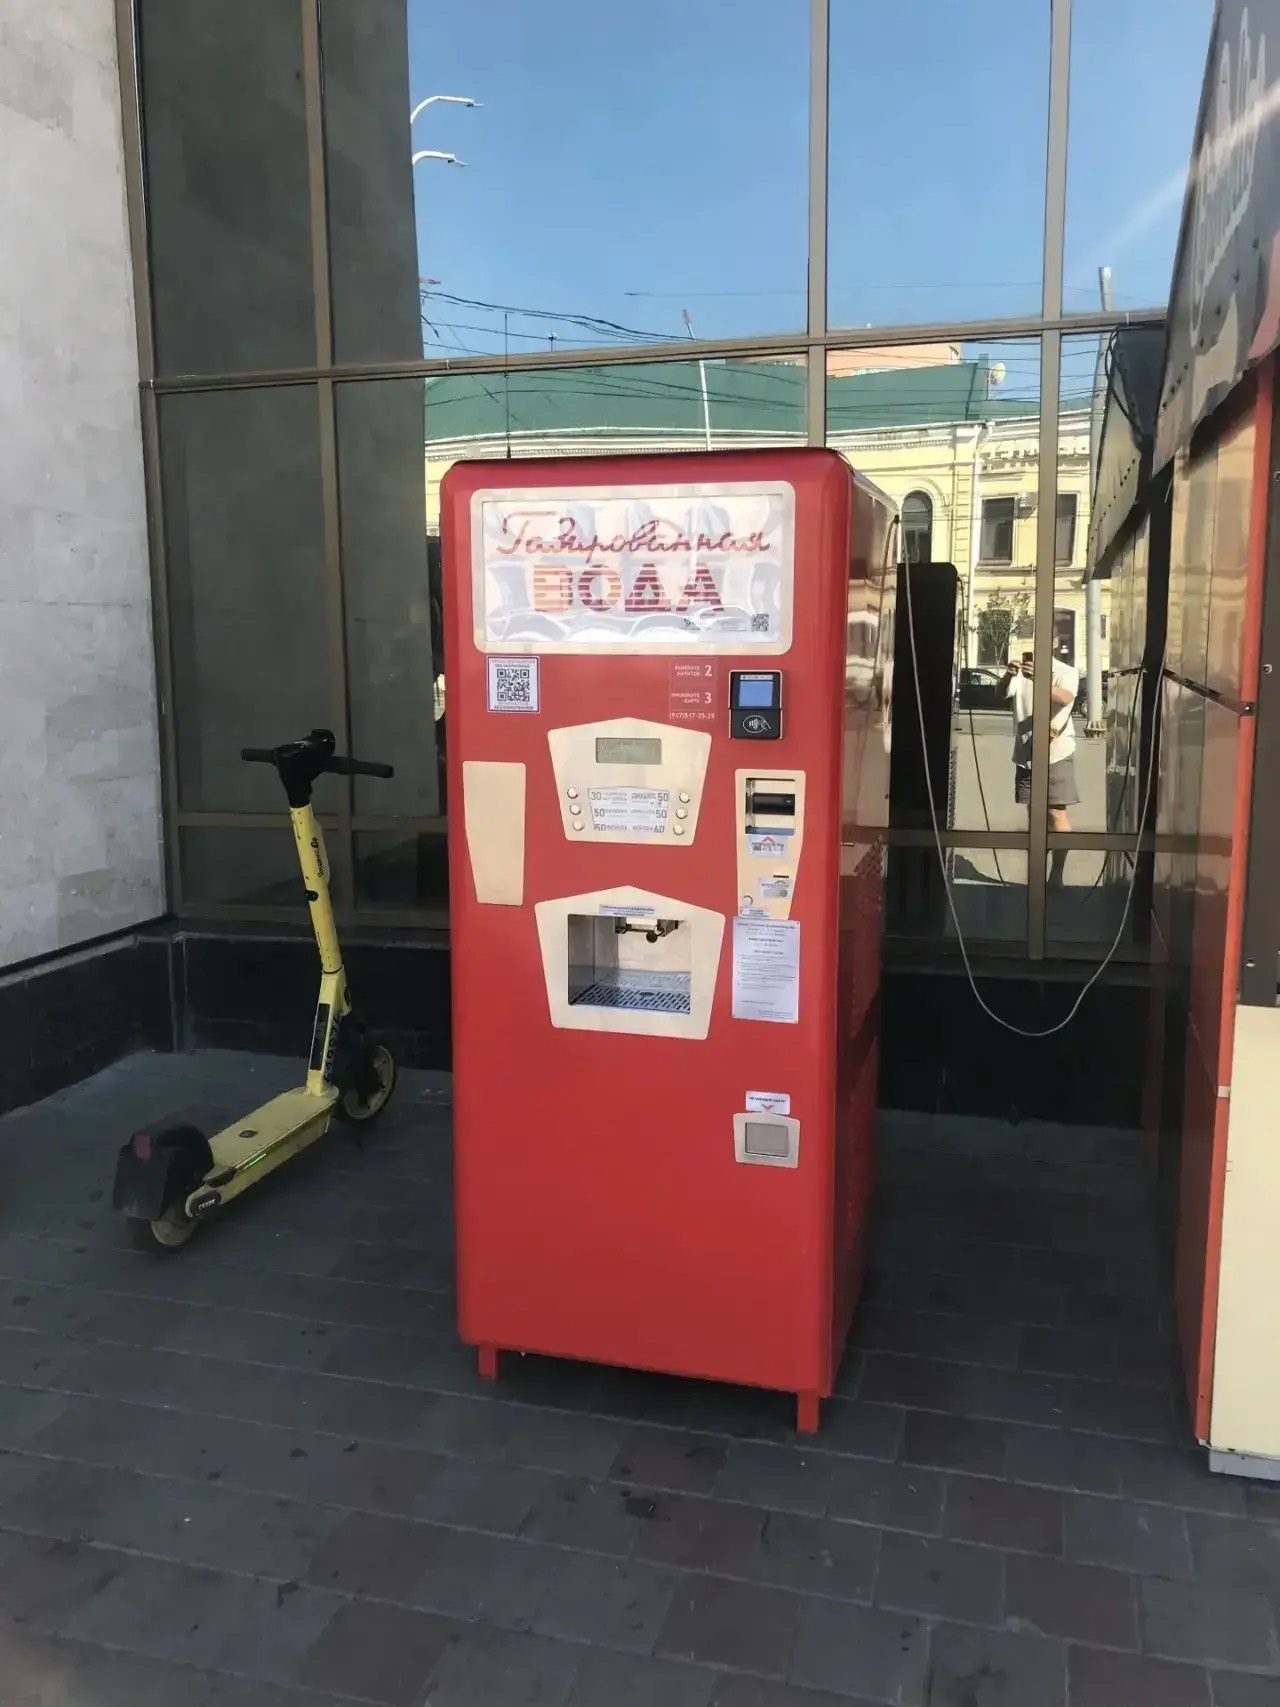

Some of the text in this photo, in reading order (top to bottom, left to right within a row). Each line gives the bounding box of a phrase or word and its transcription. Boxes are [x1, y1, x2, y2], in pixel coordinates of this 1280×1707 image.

[498, 510, 771, 563] Газированная
[533, 562, 724, 613] ВОДА
[704, 664, 713, 677] 2
[704, 692, 712, 704] 3
[591, 791, 602, 801] 30
[657, 792, 669, 802] 50
[594, 808, 605, 817] 50
[655, 809, 667, 819] 50
[653, 825, 665, 834] 60
